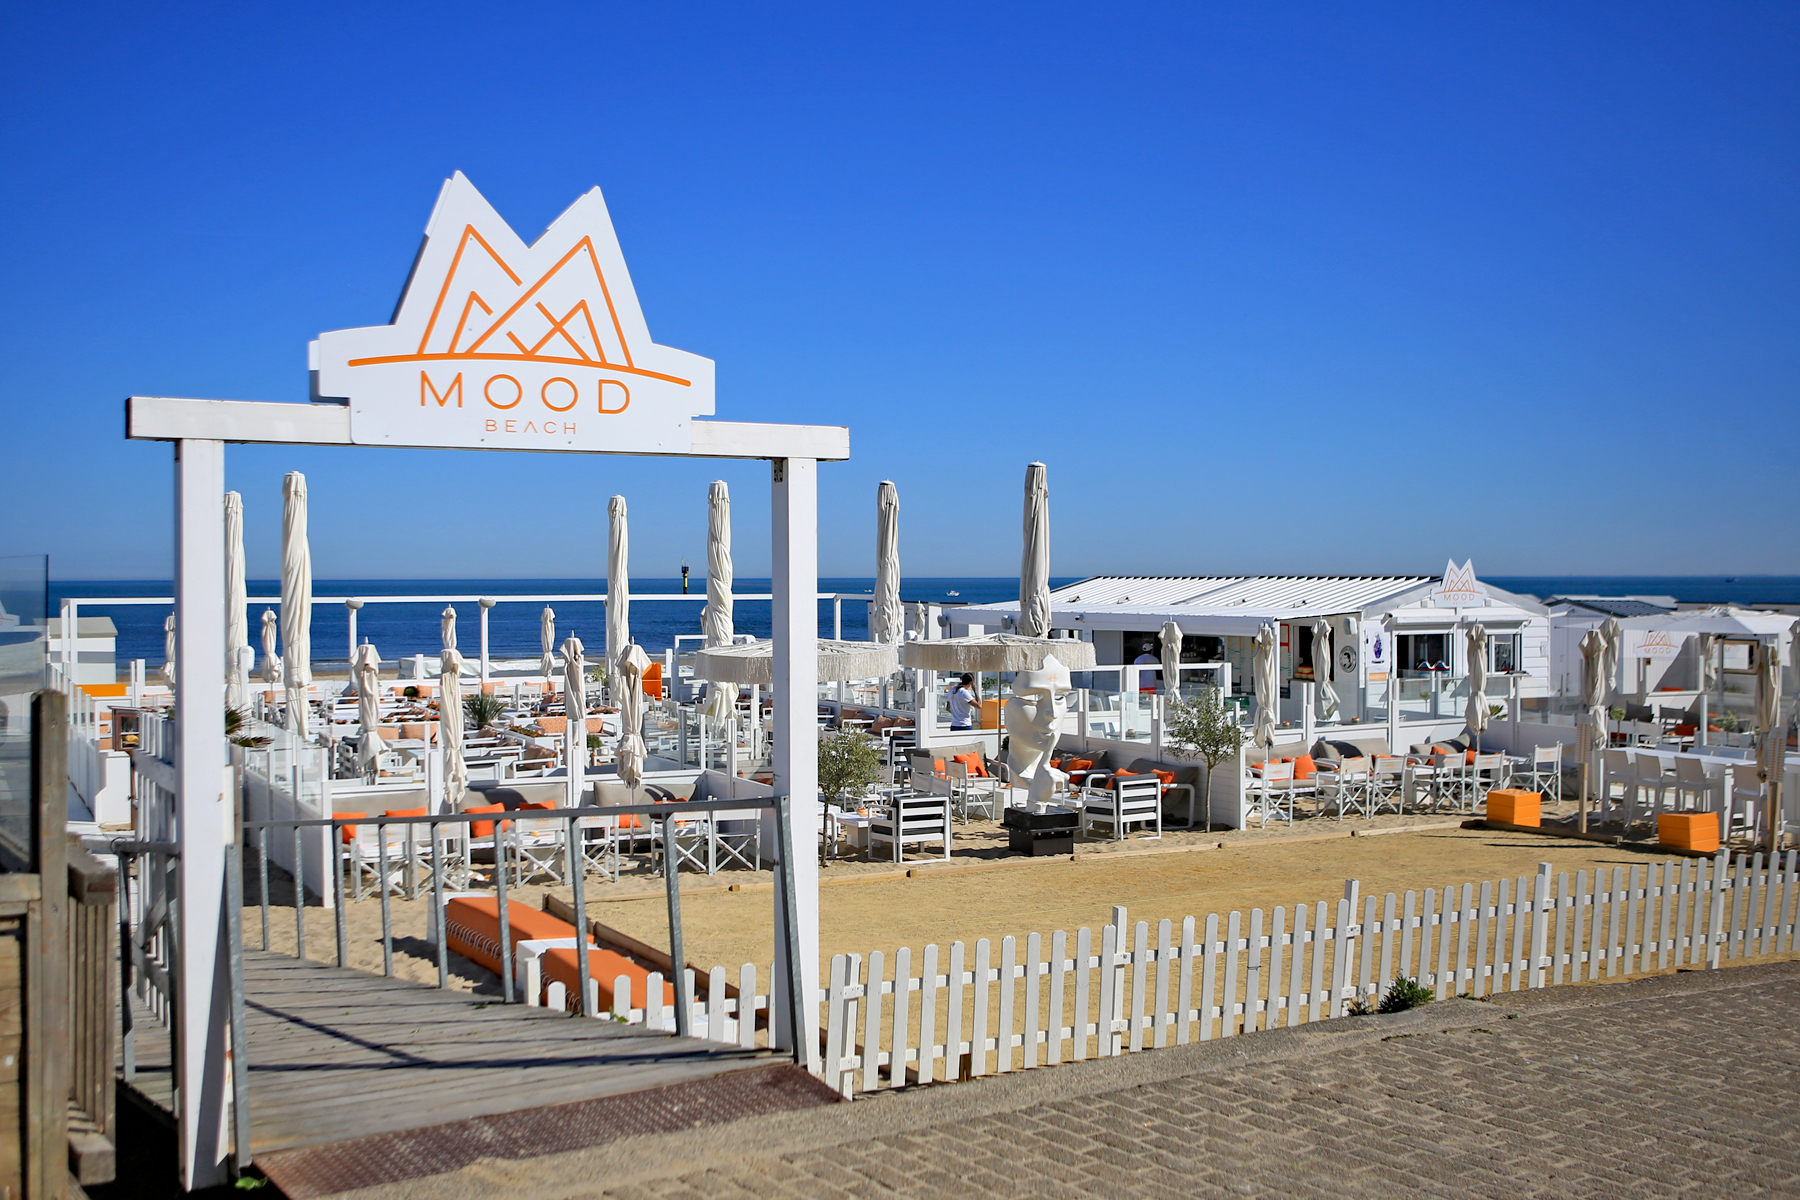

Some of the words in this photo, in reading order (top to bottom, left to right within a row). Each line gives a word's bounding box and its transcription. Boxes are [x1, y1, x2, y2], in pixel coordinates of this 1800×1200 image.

[420, 370, 630, 415] MOOD
[485, 419, 577, 435] BEACH
[1443, 593, 1475, 602] MOOD
[1644, 647, 1671, 655] MOOD
